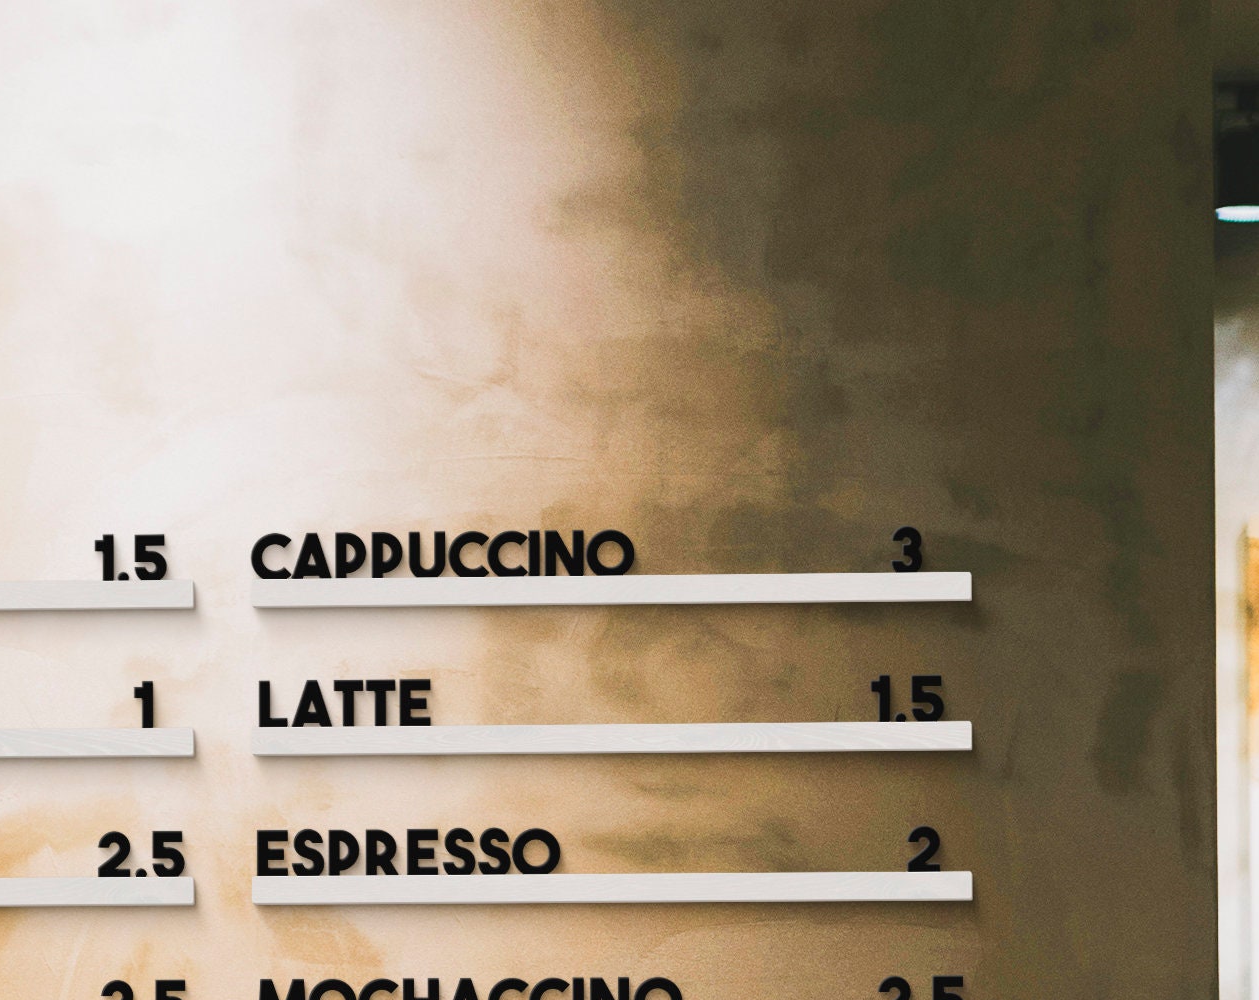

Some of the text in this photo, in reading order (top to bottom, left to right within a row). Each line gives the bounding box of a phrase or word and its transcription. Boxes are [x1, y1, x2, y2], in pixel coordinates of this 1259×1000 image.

[94, 534, 168, 581] 1.5
[250, 526, 924, 579] CAPPUCCINO 3
[134, 681, 154, 728] 1
[258, 675, 945, 727] LATTE 1.5
[97, 831, 186, 877] 2.5
[257, 827, 941, 876] ESPRESSO 2
